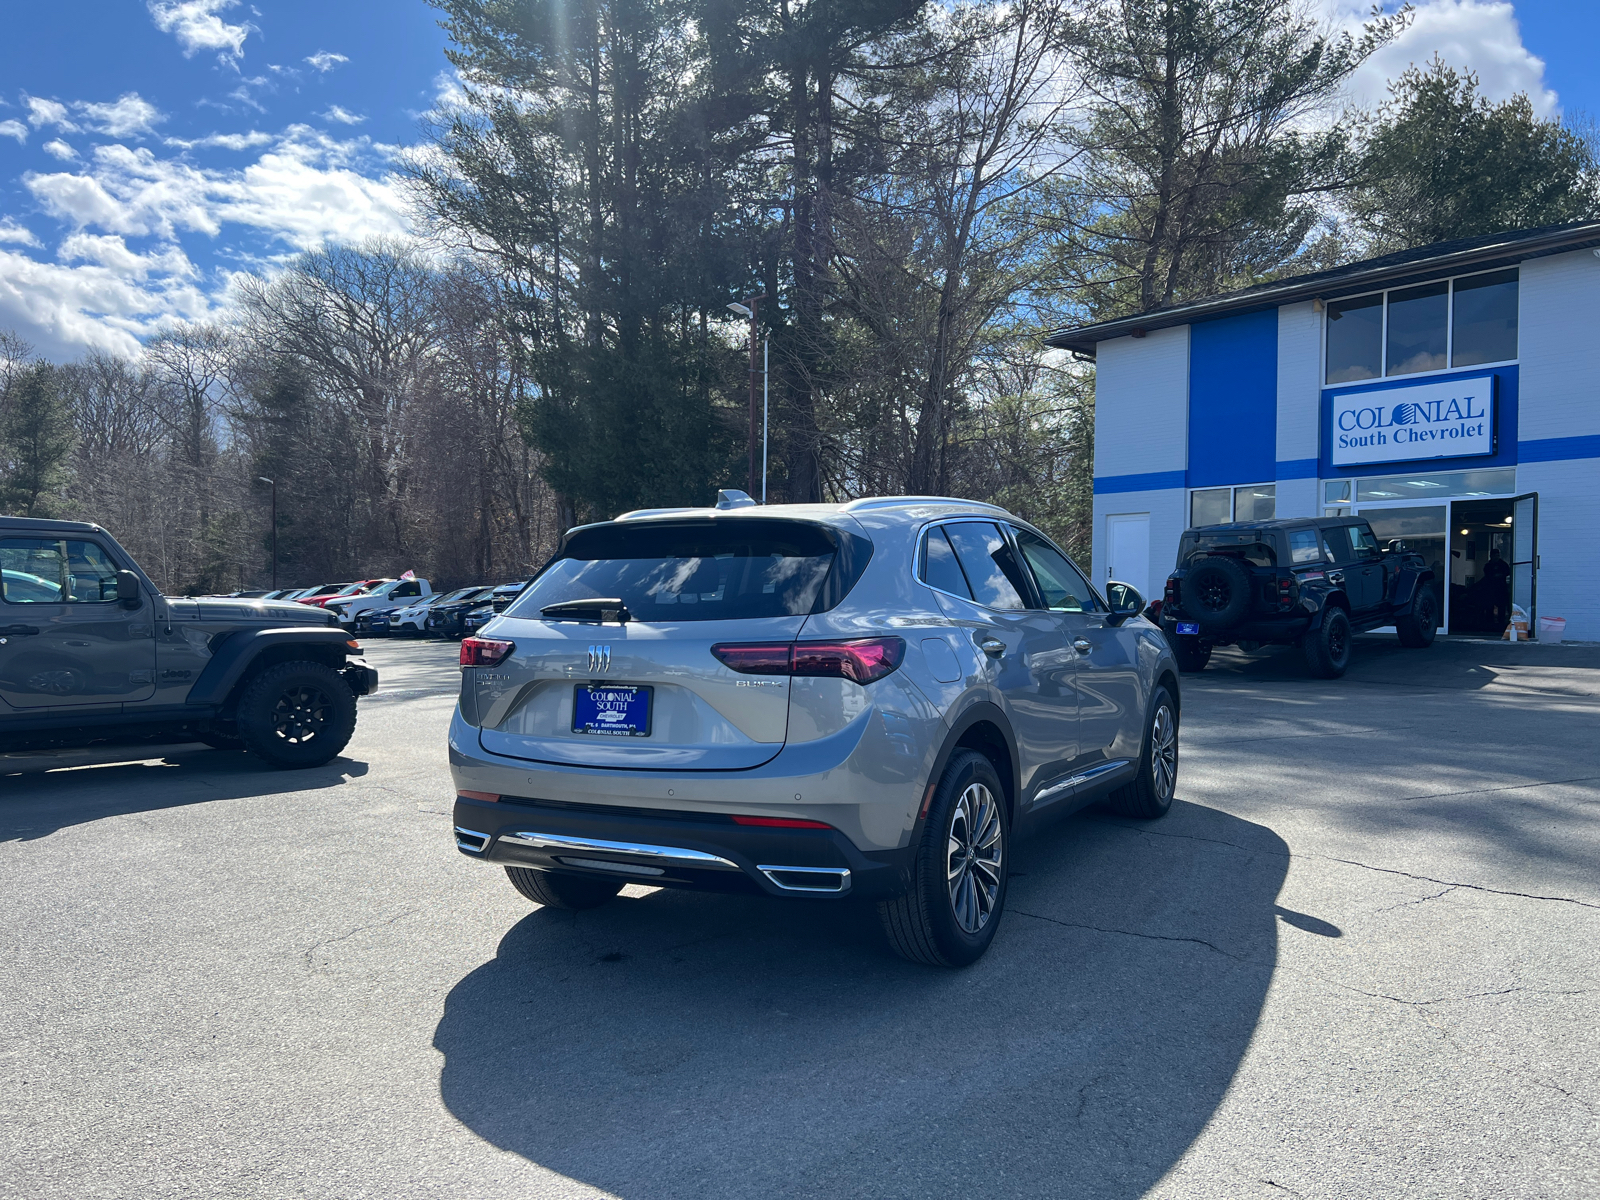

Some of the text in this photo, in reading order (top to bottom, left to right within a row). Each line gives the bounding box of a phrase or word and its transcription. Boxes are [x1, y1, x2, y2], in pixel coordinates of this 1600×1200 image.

[1338, 396, 1485, 432] COLONIAL
[1338, 422, 1484, 449] South Chevrolet
[162, 669, 192, 679] Jeep
[590, 692, 635, 702] COLONIAL
[596, 701, 627, 711] SOUTH
